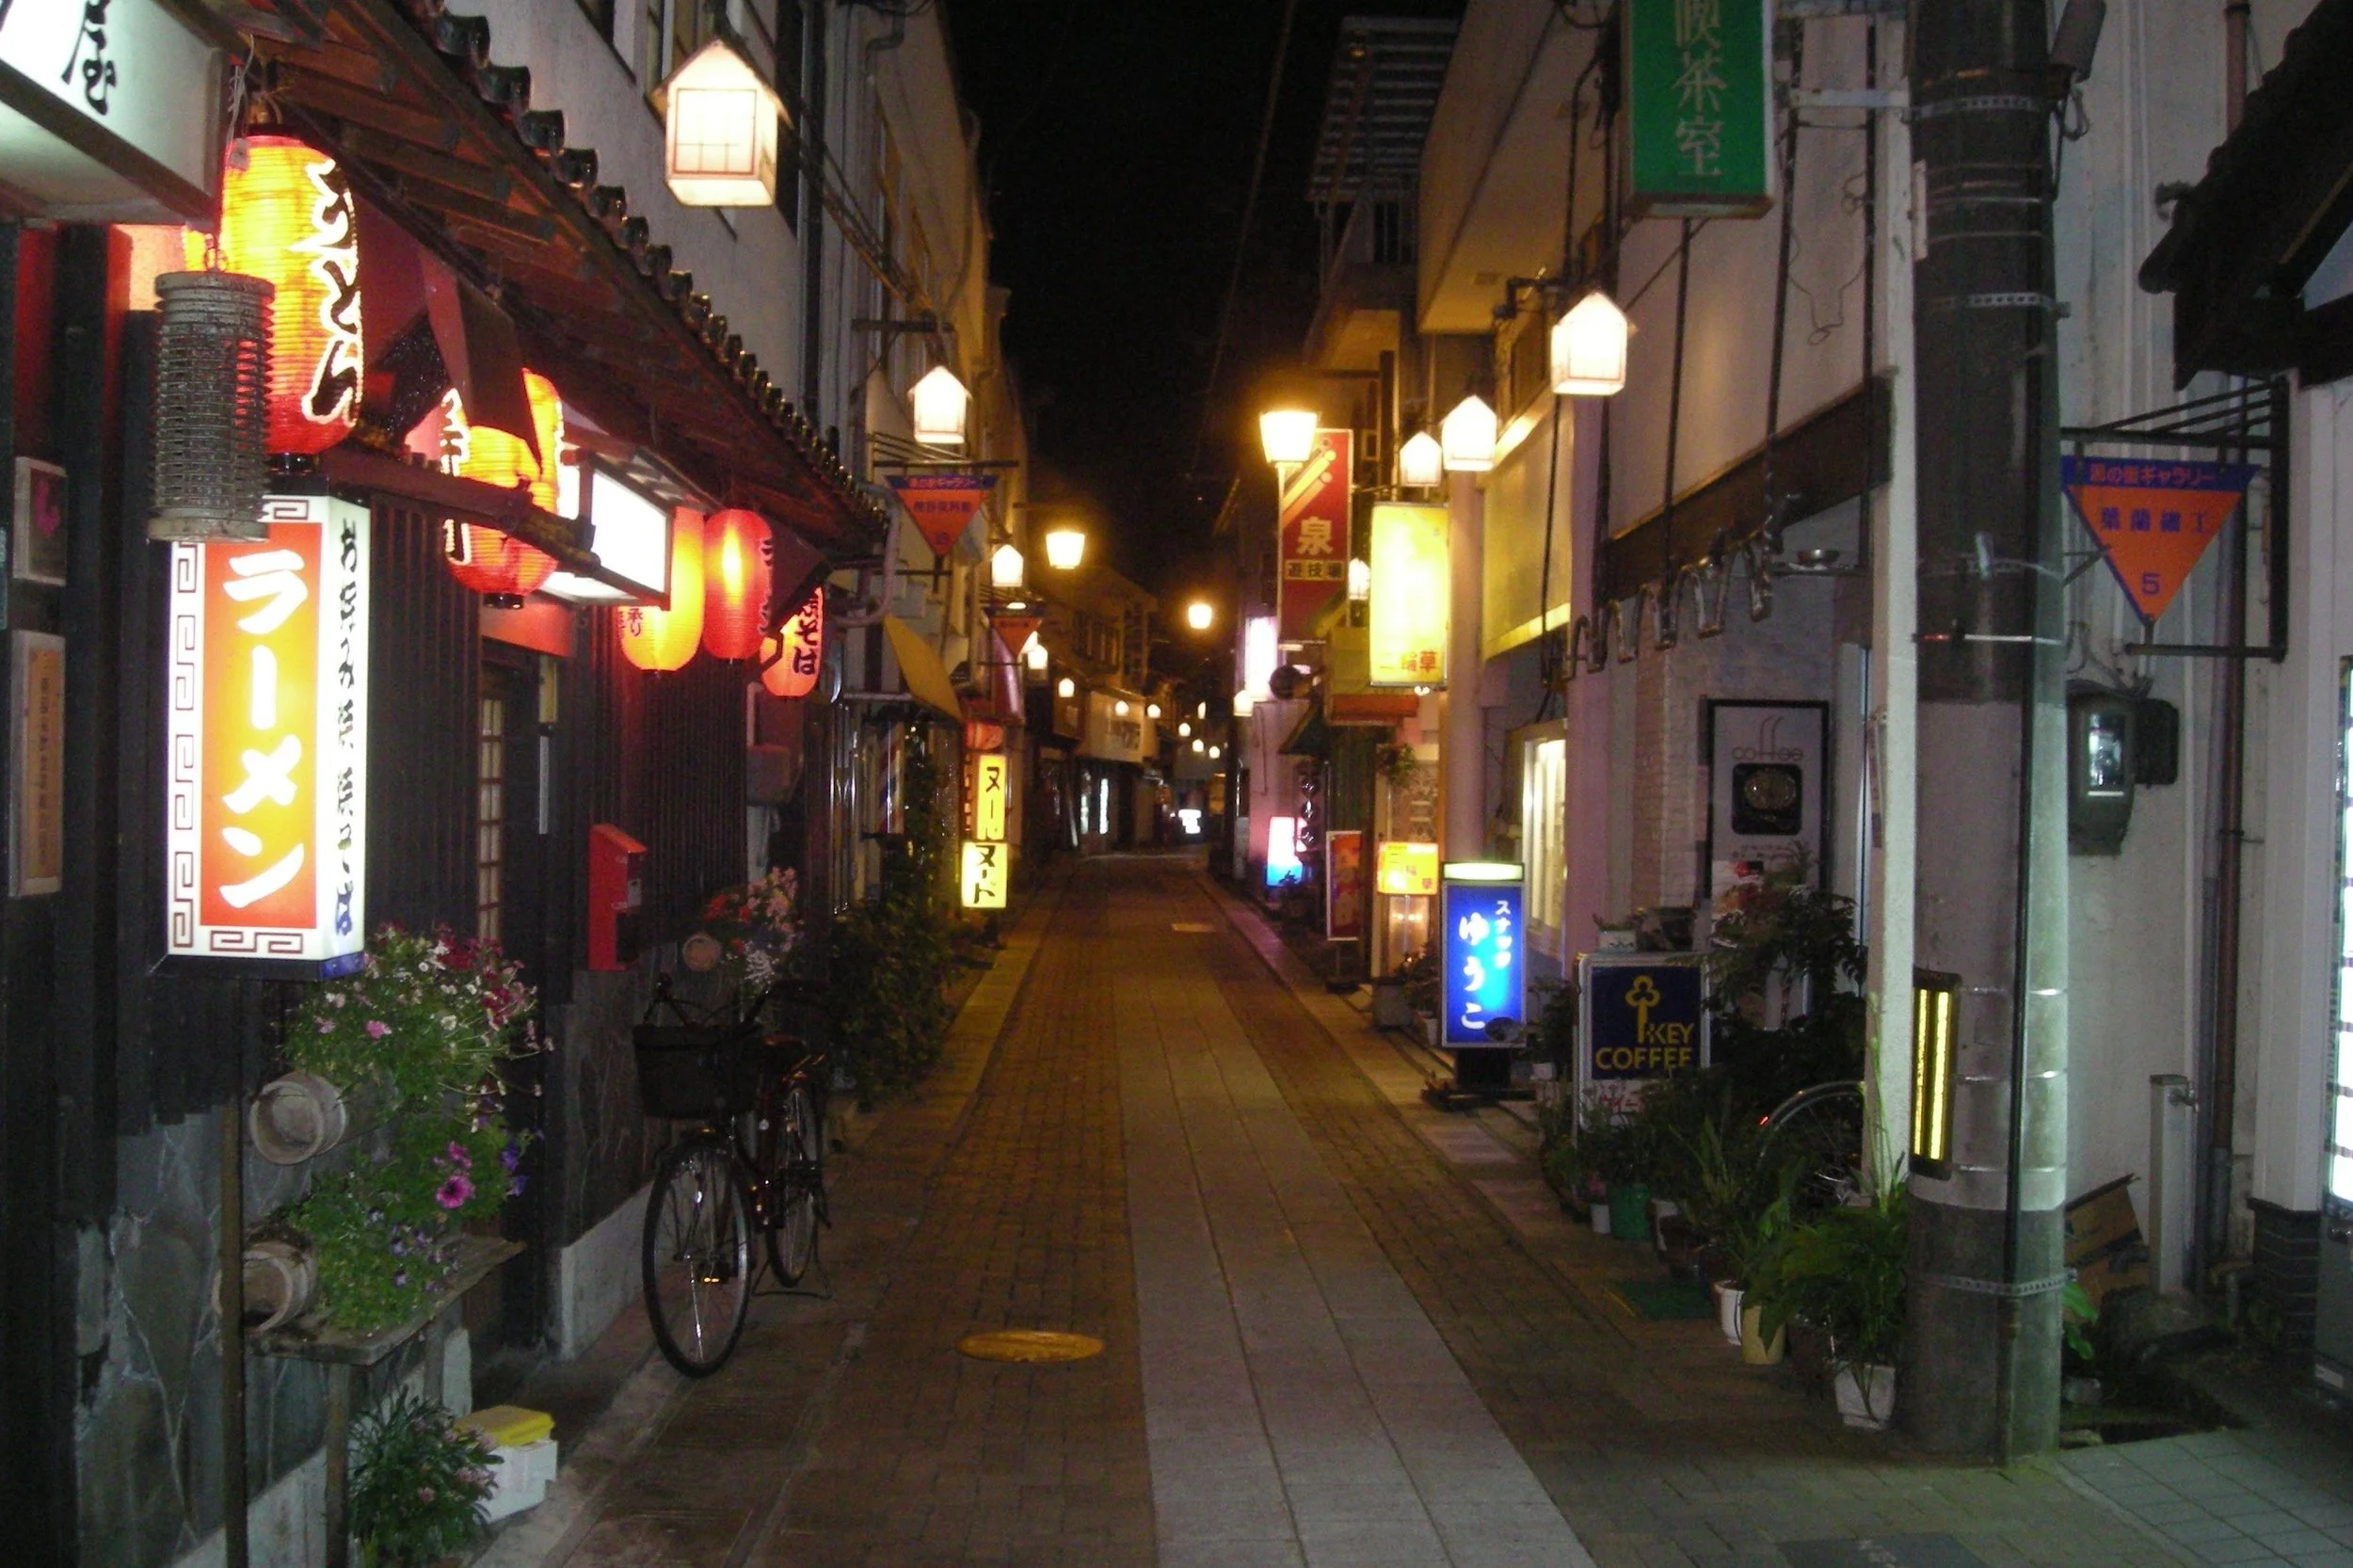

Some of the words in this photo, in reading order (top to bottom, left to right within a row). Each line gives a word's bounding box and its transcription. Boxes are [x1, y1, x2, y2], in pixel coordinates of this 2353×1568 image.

[1295, 516, 1335, 556] 泉
[2140, 571, 2161, 596] 5
[218, 549, 309, 909] ラーメン
[1732, 715, 1805, 761] coffee
[974, 844, 996, 904] ヌード
[1459, 911, 1491, 1031] ゆうこ
[1647, 1022, 1695, 1045] KEY
[1594, 1047, 1693, 1071] COFFEE
